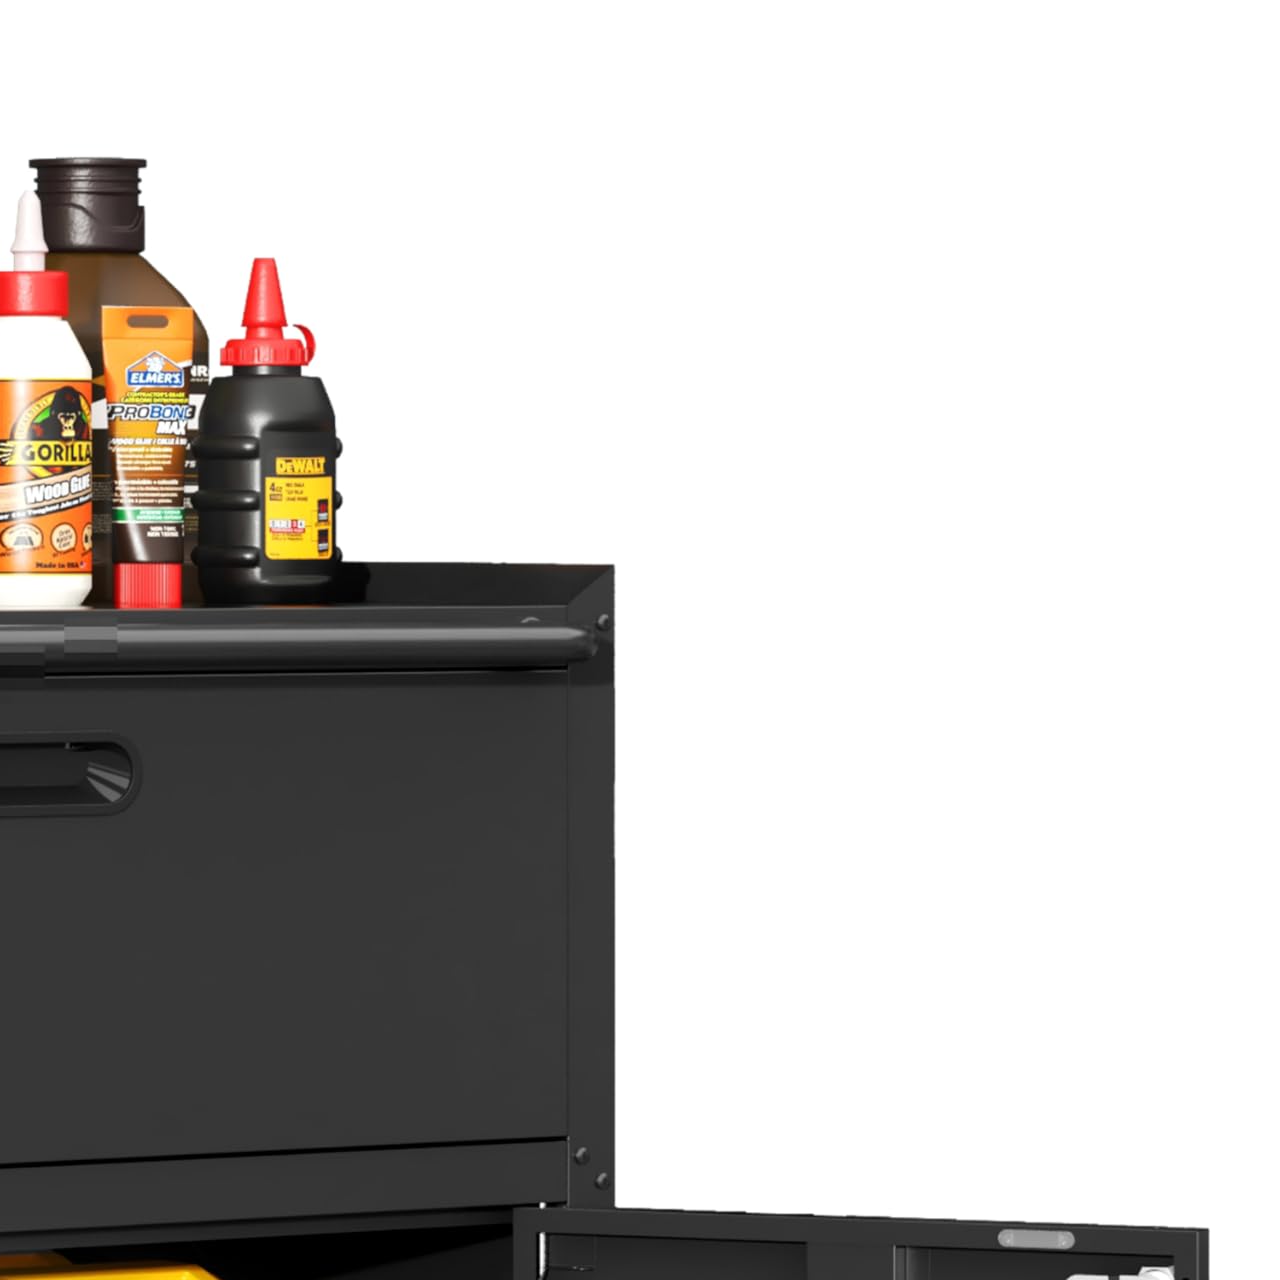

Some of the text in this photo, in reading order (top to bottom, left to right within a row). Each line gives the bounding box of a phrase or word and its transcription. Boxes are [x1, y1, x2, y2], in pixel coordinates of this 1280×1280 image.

[130, 373, 181, 384] ELMER'S
[108, 404, 196, 420] PROBOND
[156, 421, 186, 435] MAX
[22, 444, 91, 461] GORILLA
[277, 458, 324, 474] DEWALT
[25, 482, 70, 504] WOOD
